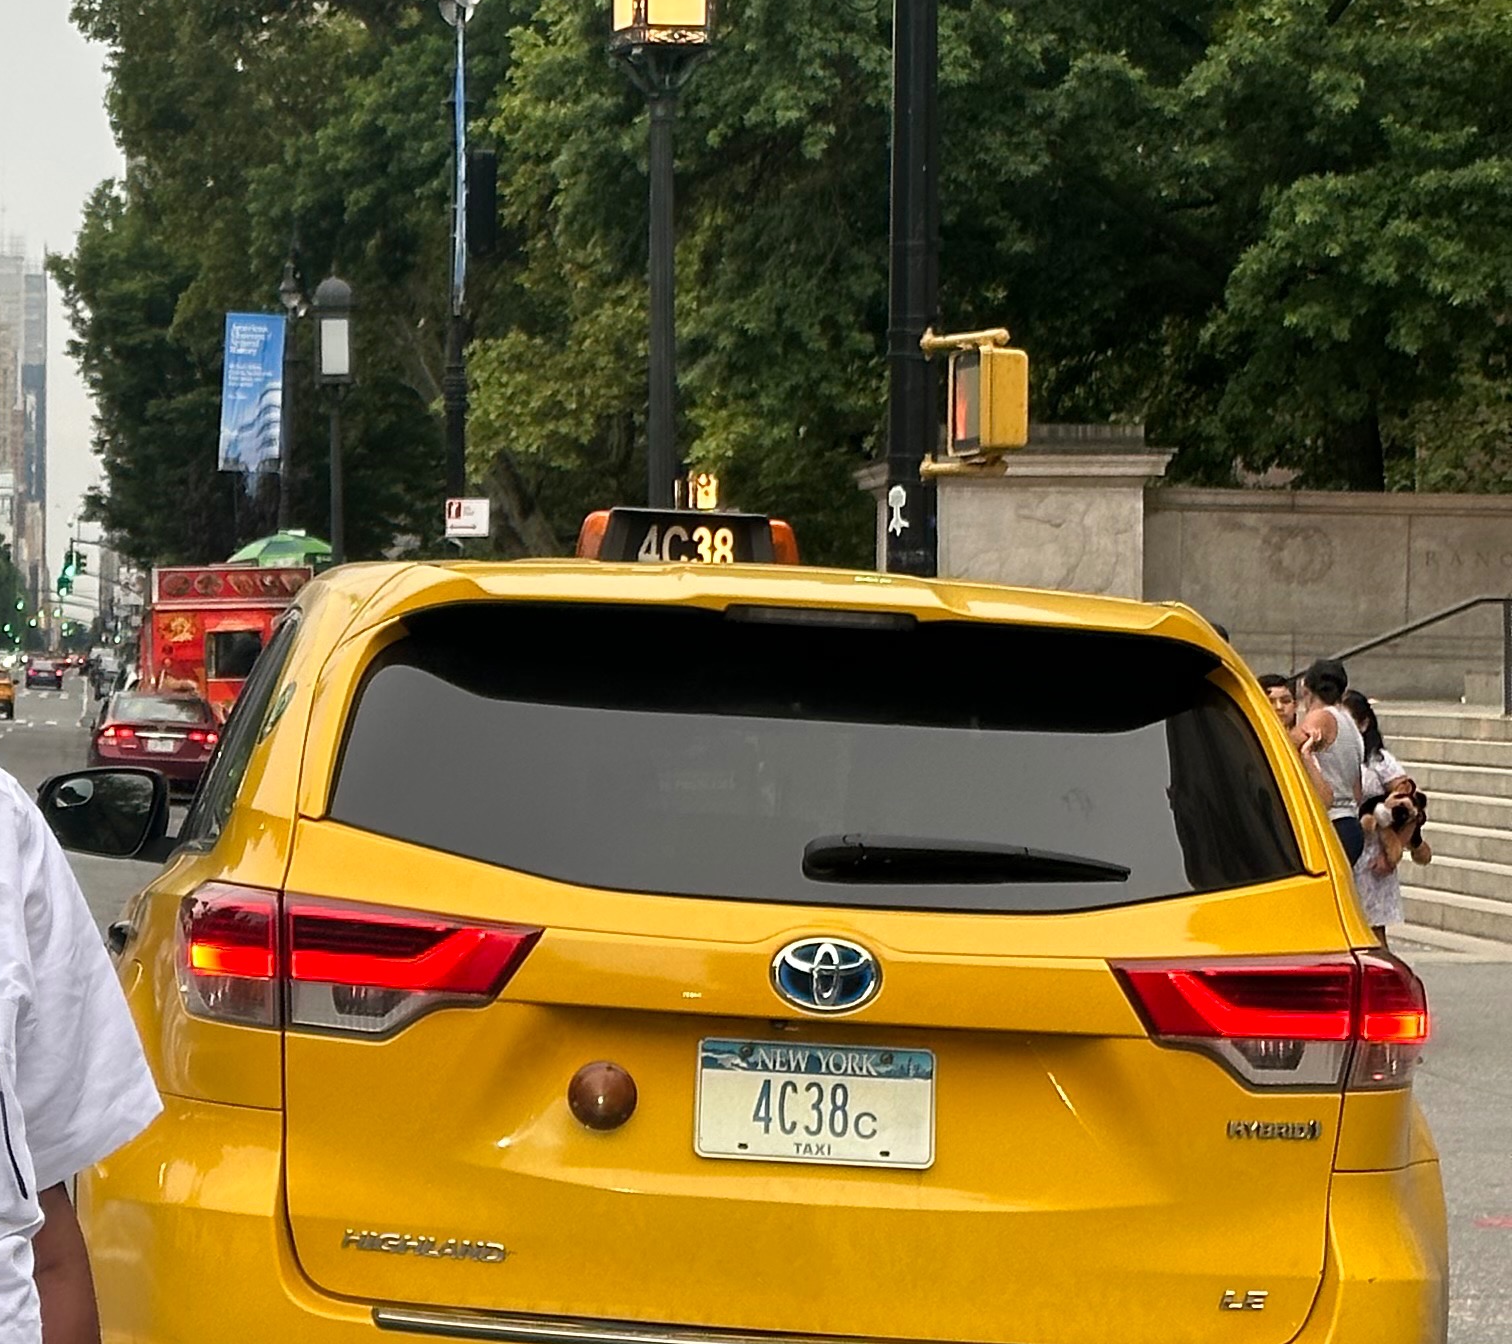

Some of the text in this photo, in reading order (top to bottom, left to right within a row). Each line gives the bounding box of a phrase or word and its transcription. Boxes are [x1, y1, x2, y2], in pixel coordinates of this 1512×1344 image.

[637, 524, 734, 564] 4C38
[756, 1047, 878, 1076] NEW YORK
[794, 1142, 831, 1156] TAXI
[1219, 1289, 1269, 1311] LE
